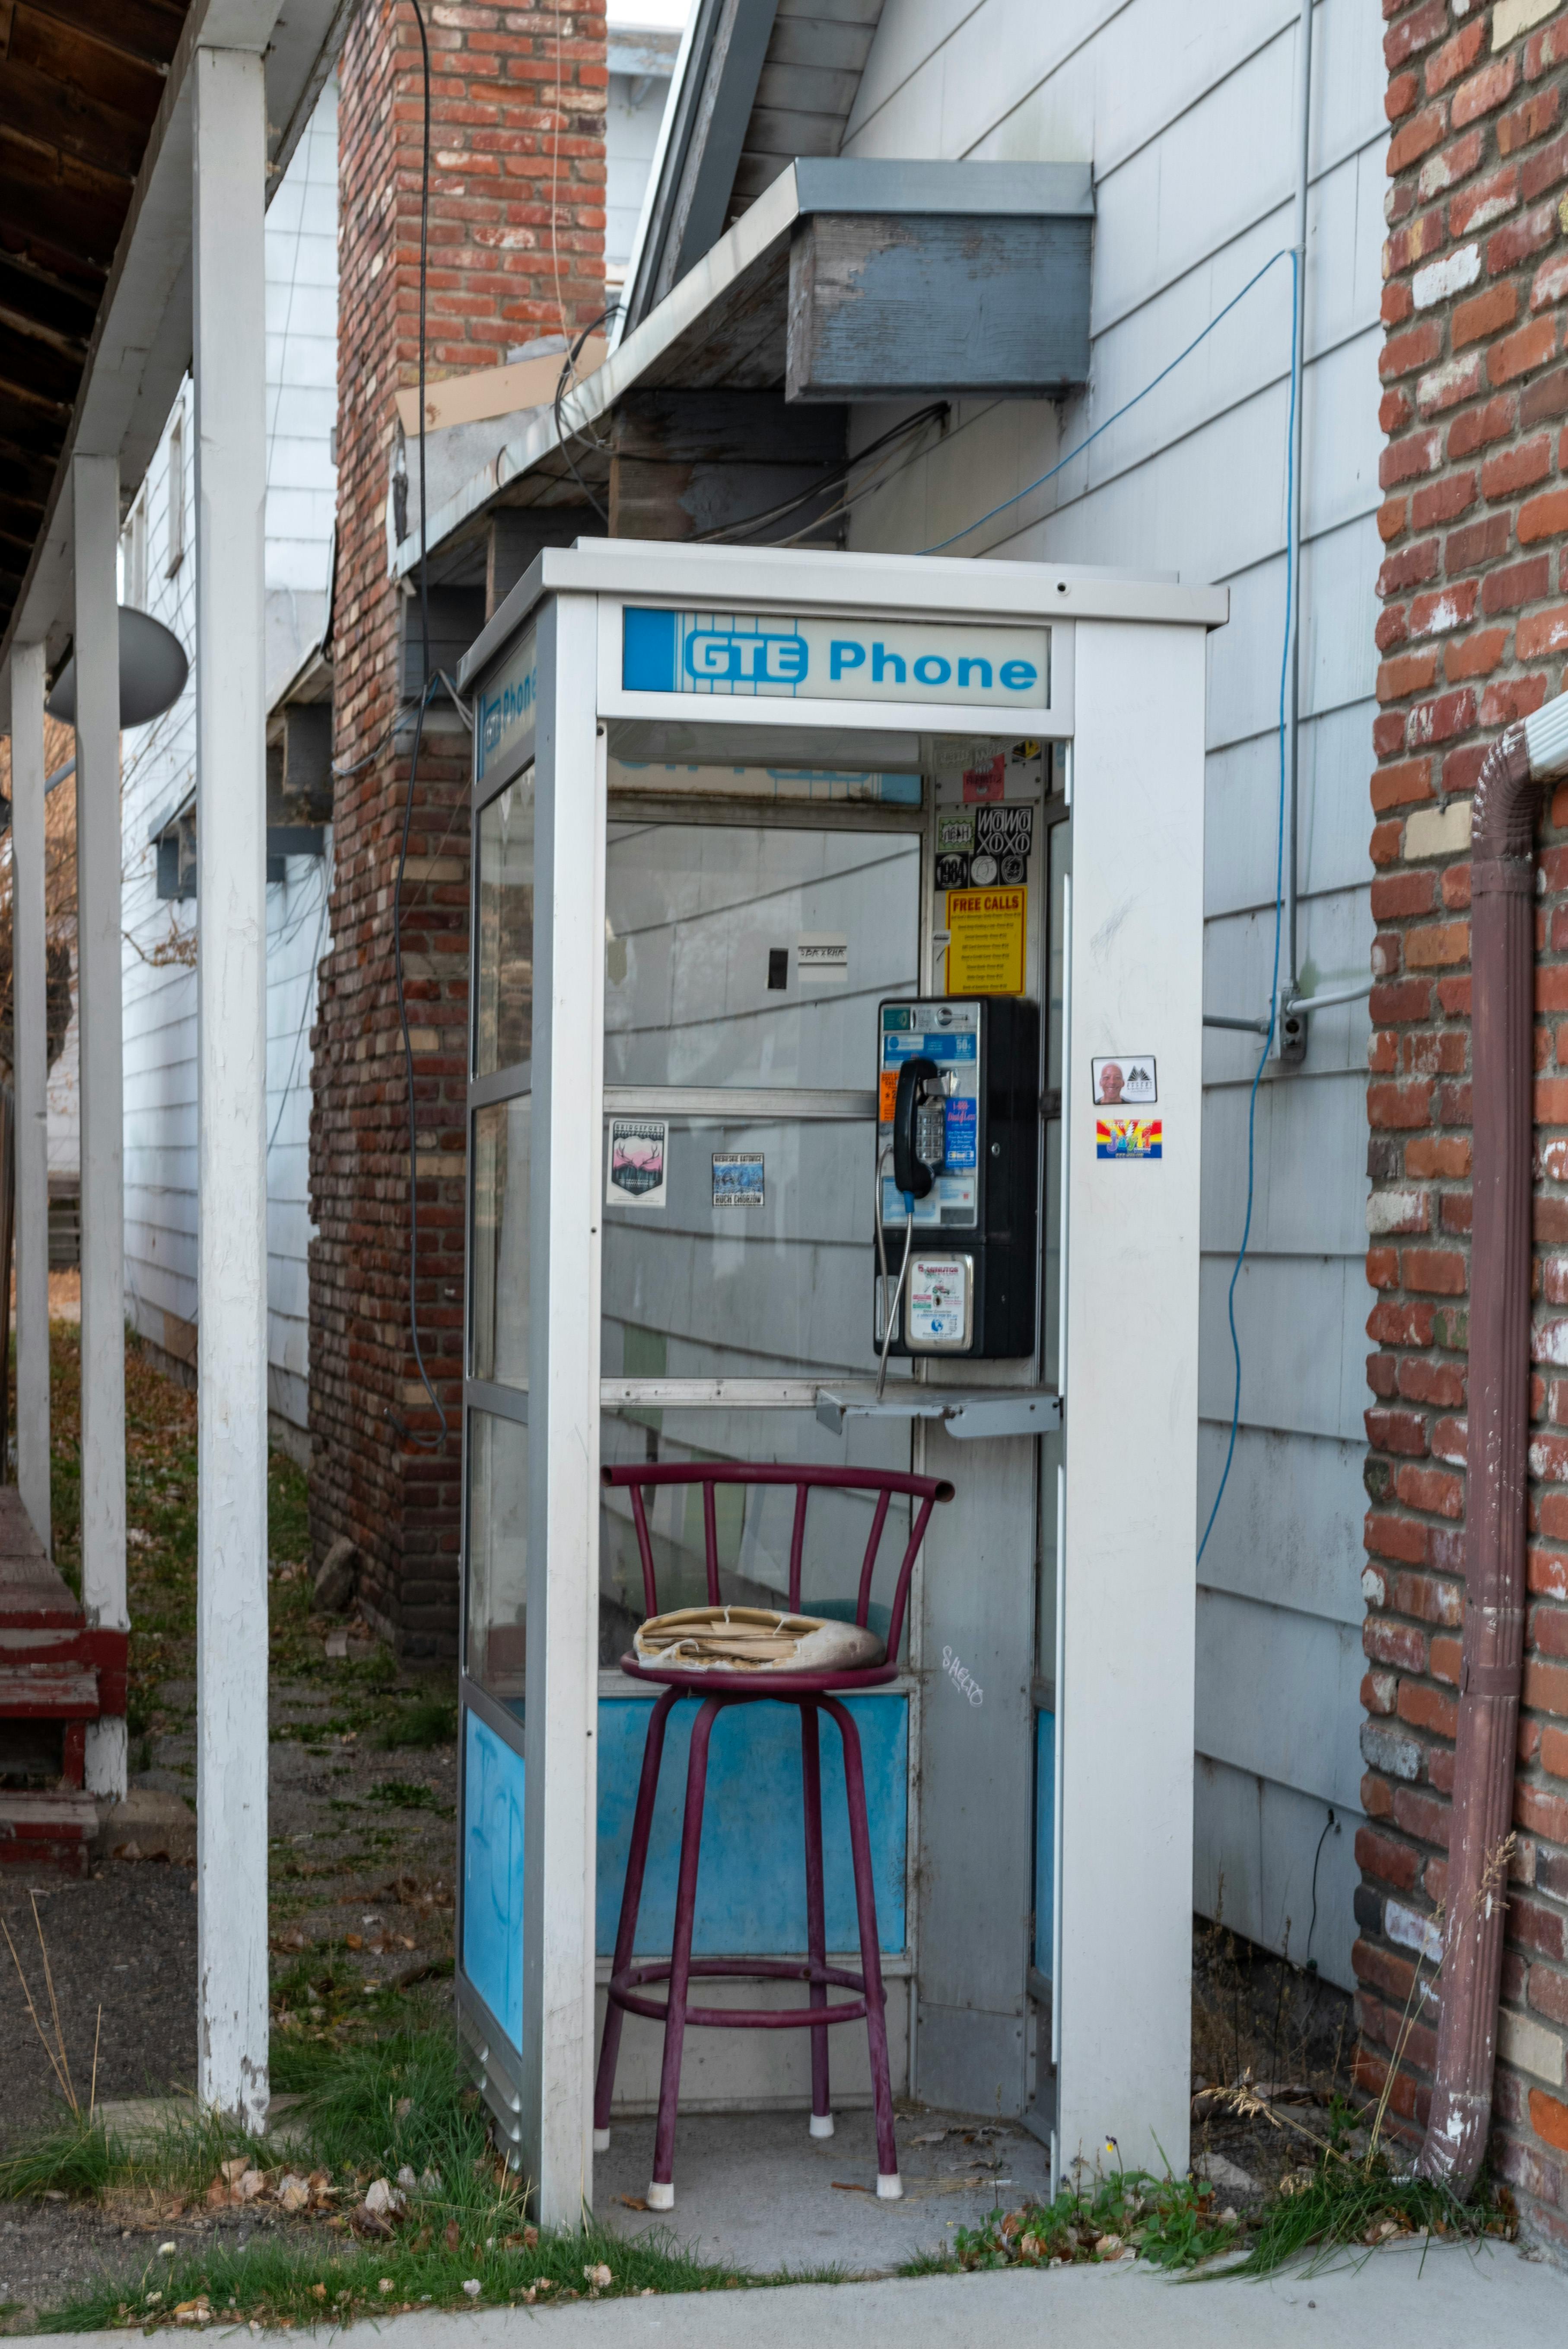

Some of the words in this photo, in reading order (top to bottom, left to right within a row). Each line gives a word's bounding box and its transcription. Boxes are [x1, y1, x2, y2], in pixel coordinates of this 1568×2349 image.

[693, 635, 800, 678] GTE
[830, 640, 1038, 690] Phone
[953, 897, 981, 912] FREE
[984, 895, 1019, 910] CALLS
